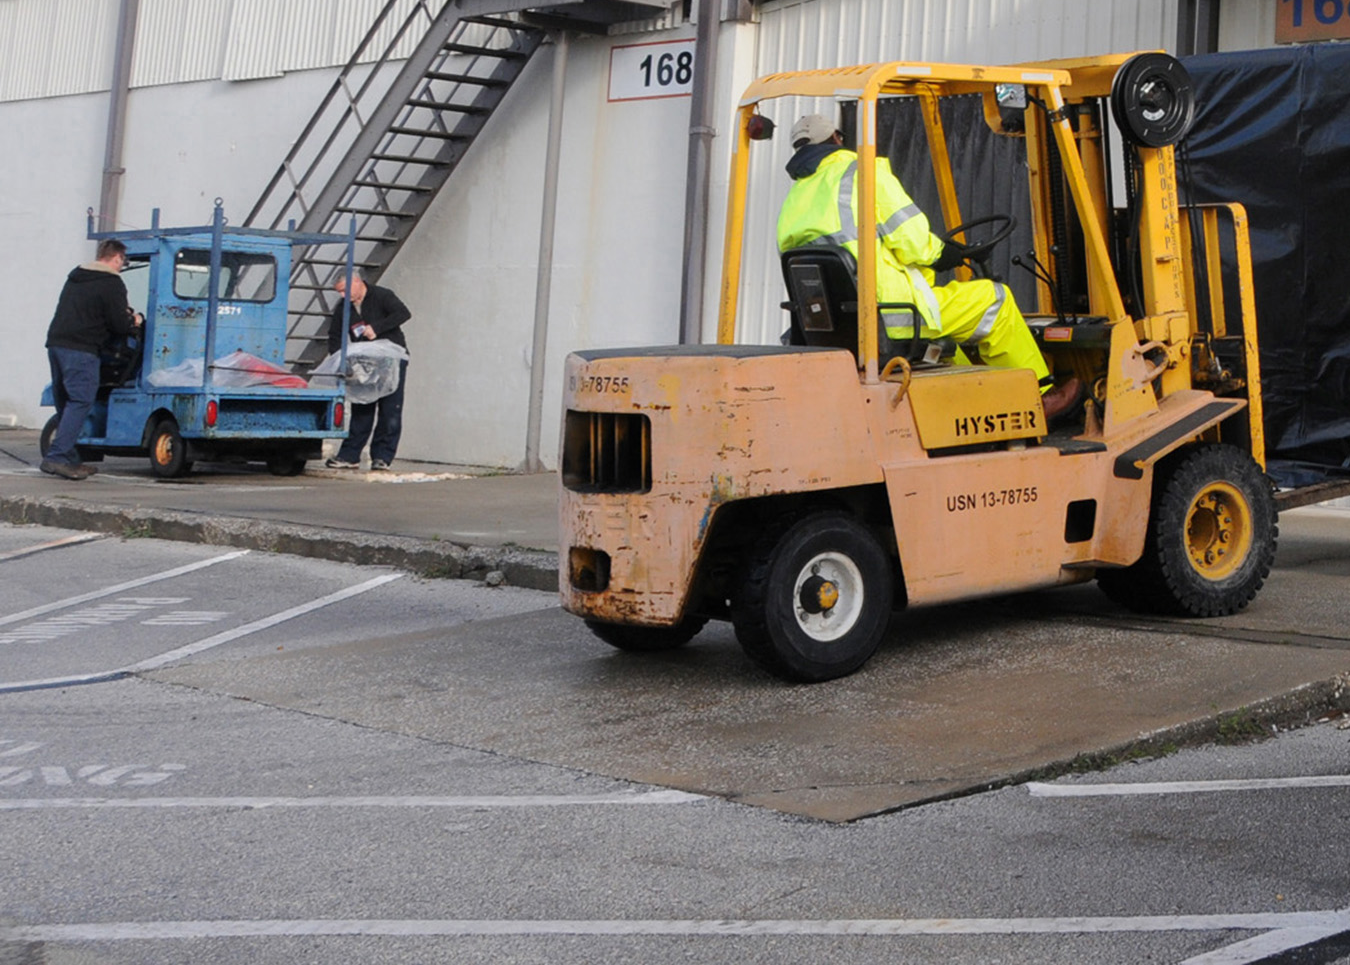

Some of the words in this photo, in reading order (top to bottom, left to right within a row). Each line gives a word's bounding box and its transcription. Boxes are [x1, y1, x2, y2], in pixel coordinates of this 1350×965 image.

[639, 51, 693, 87] 168
[955, 410, 1037, 436] HYSTER
[946, 493, 976, 512] USN
[981, 487, 1038, 508] 13-78755
